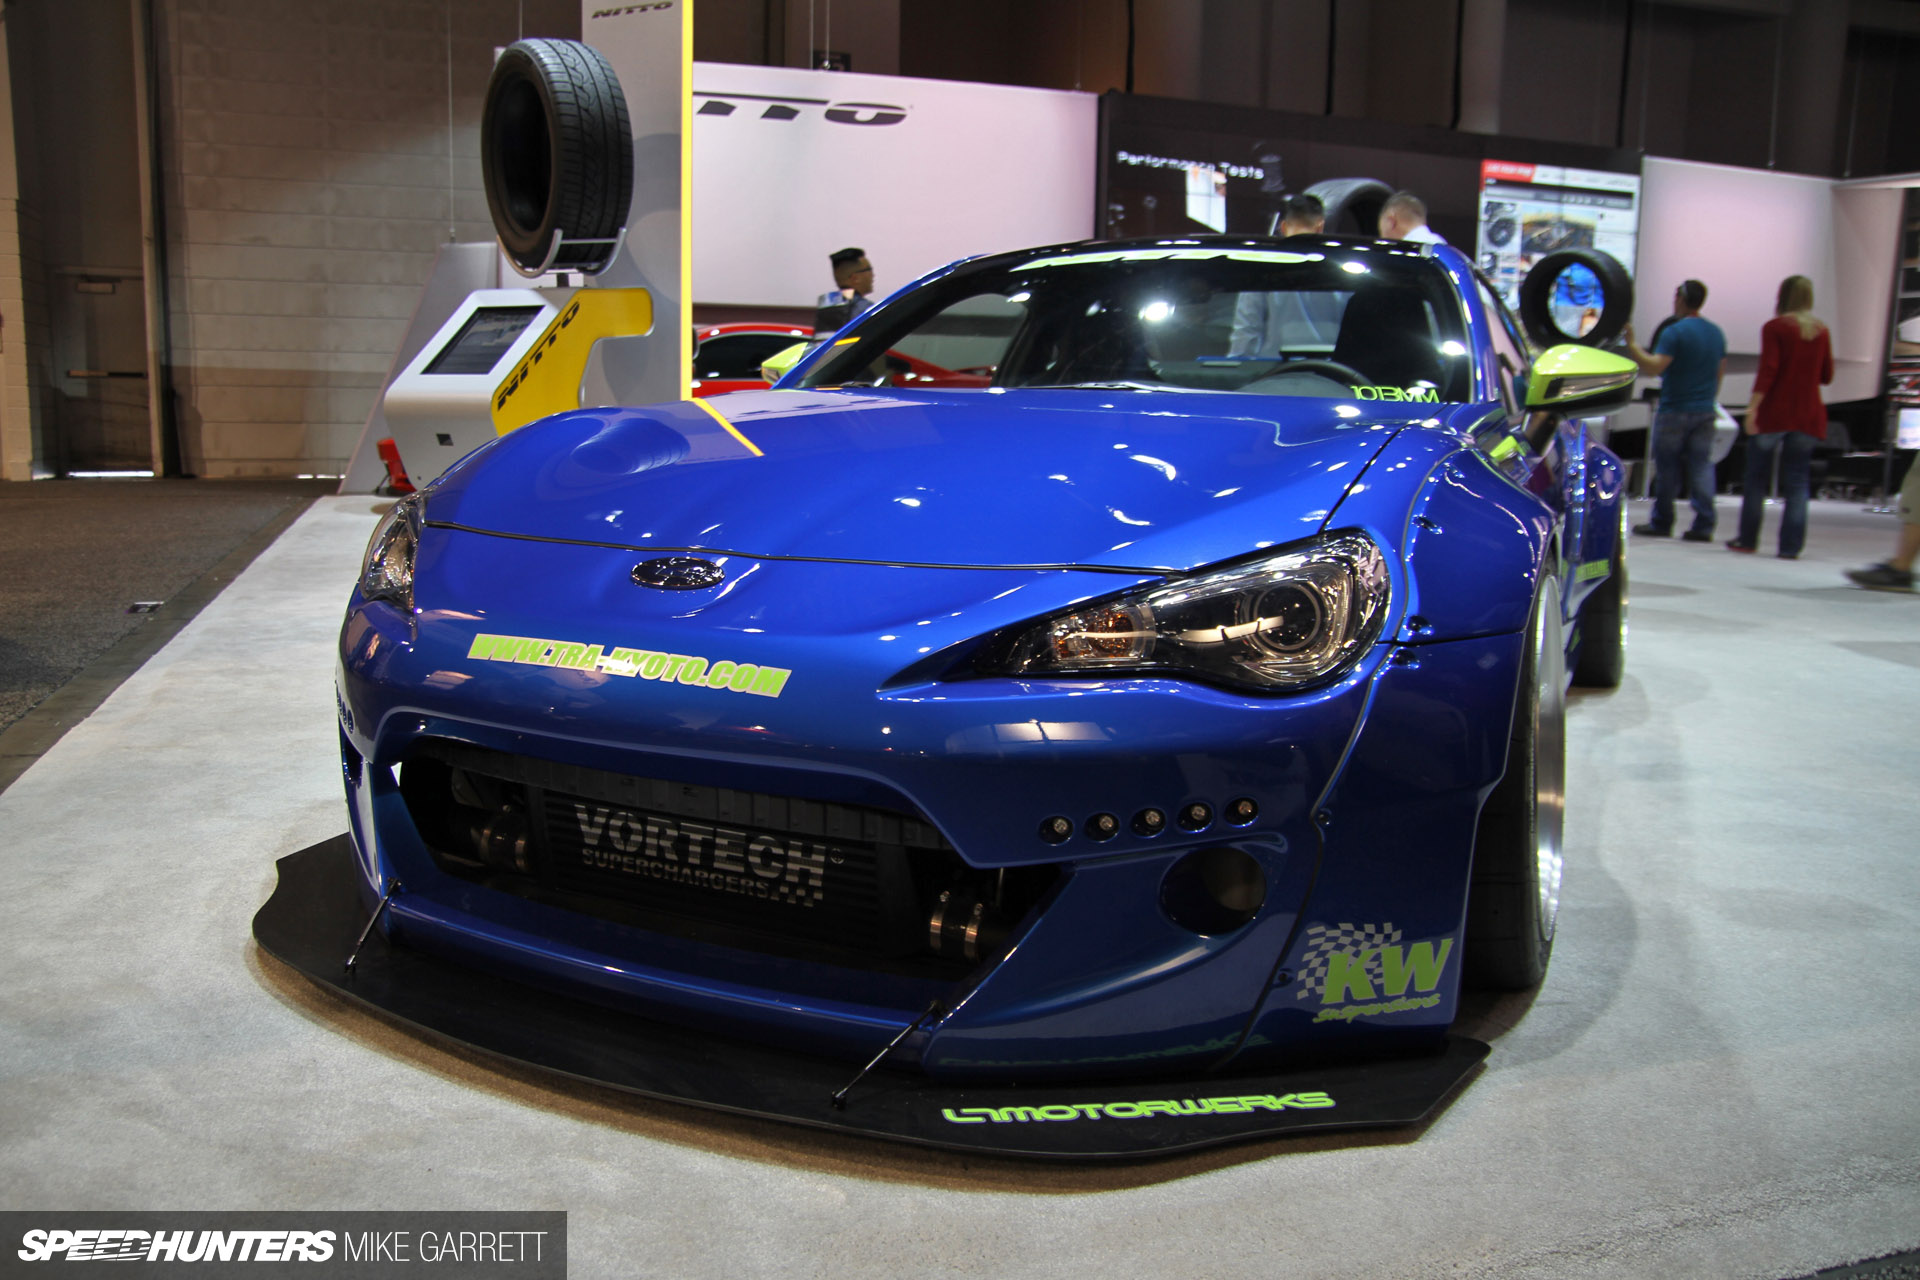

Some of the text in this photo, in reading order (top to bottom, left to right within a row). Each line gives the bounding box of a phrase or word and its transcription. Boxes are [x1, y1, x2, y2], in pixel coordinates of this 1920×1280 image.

[592, 1, 673, 19] NITTO
[692, 91, 907, 126] TTO
[1219, 161, 1265, 180] Tests
[497, 301, 580, 411] NITTO
[467, 633, 792, 698] WWW.TRA-KYOTO.COM
[574, 804, 826, 887] VORTECH
[582, 848, 769, 899] SUPERCHARGERS
[1320, 938, 1453, 1004] KW
